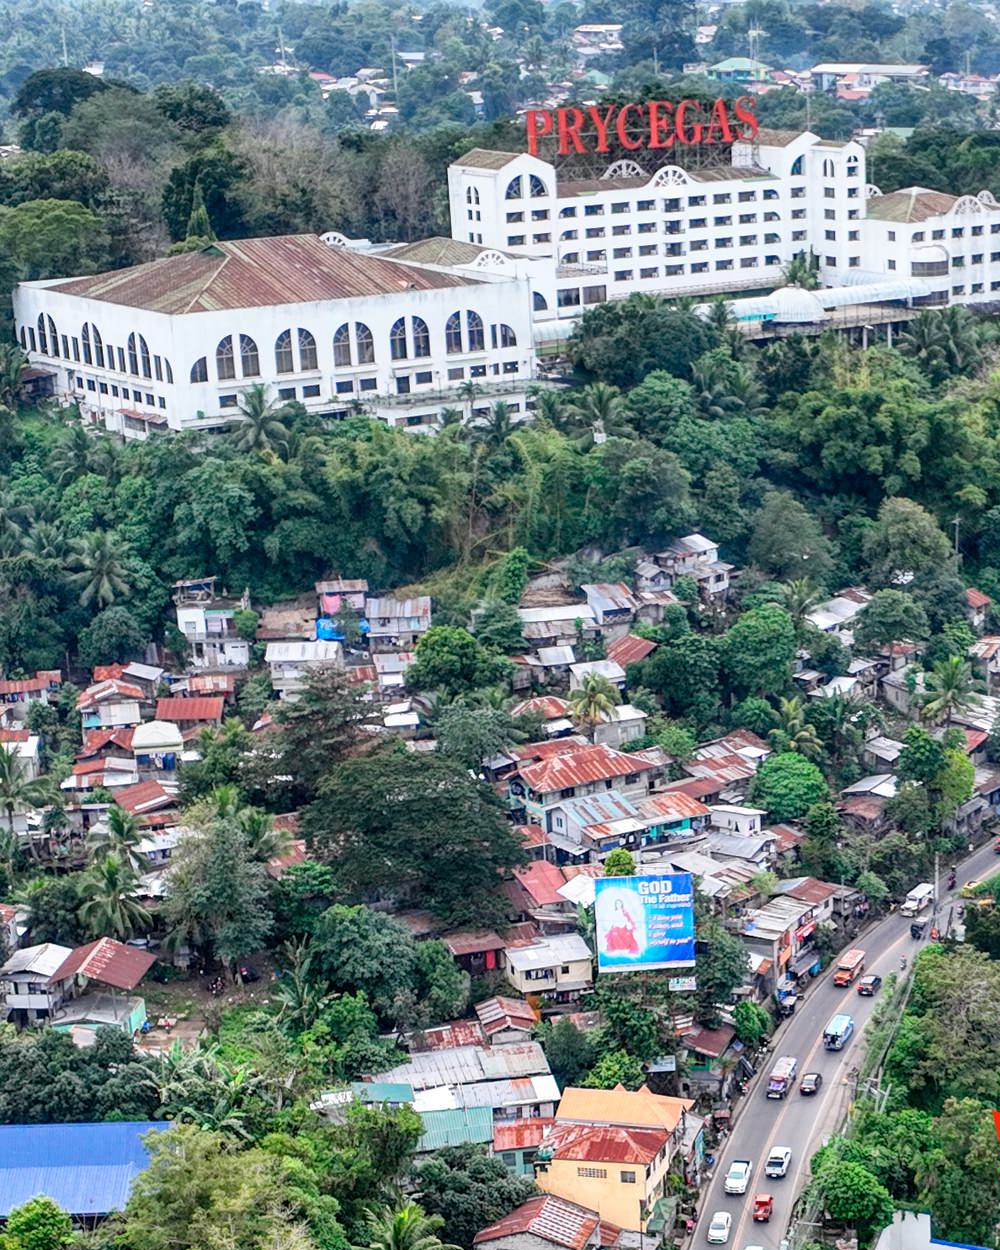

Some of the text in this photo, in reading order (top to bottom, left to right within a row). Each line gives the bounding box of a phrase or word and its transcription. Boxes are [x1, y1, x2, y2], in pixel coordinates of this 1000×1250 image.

[525, 95, 760, 157] PRYCEGAS
[638, 881, 672, 894] GOD
[640, 893, 690, 904] The Father
